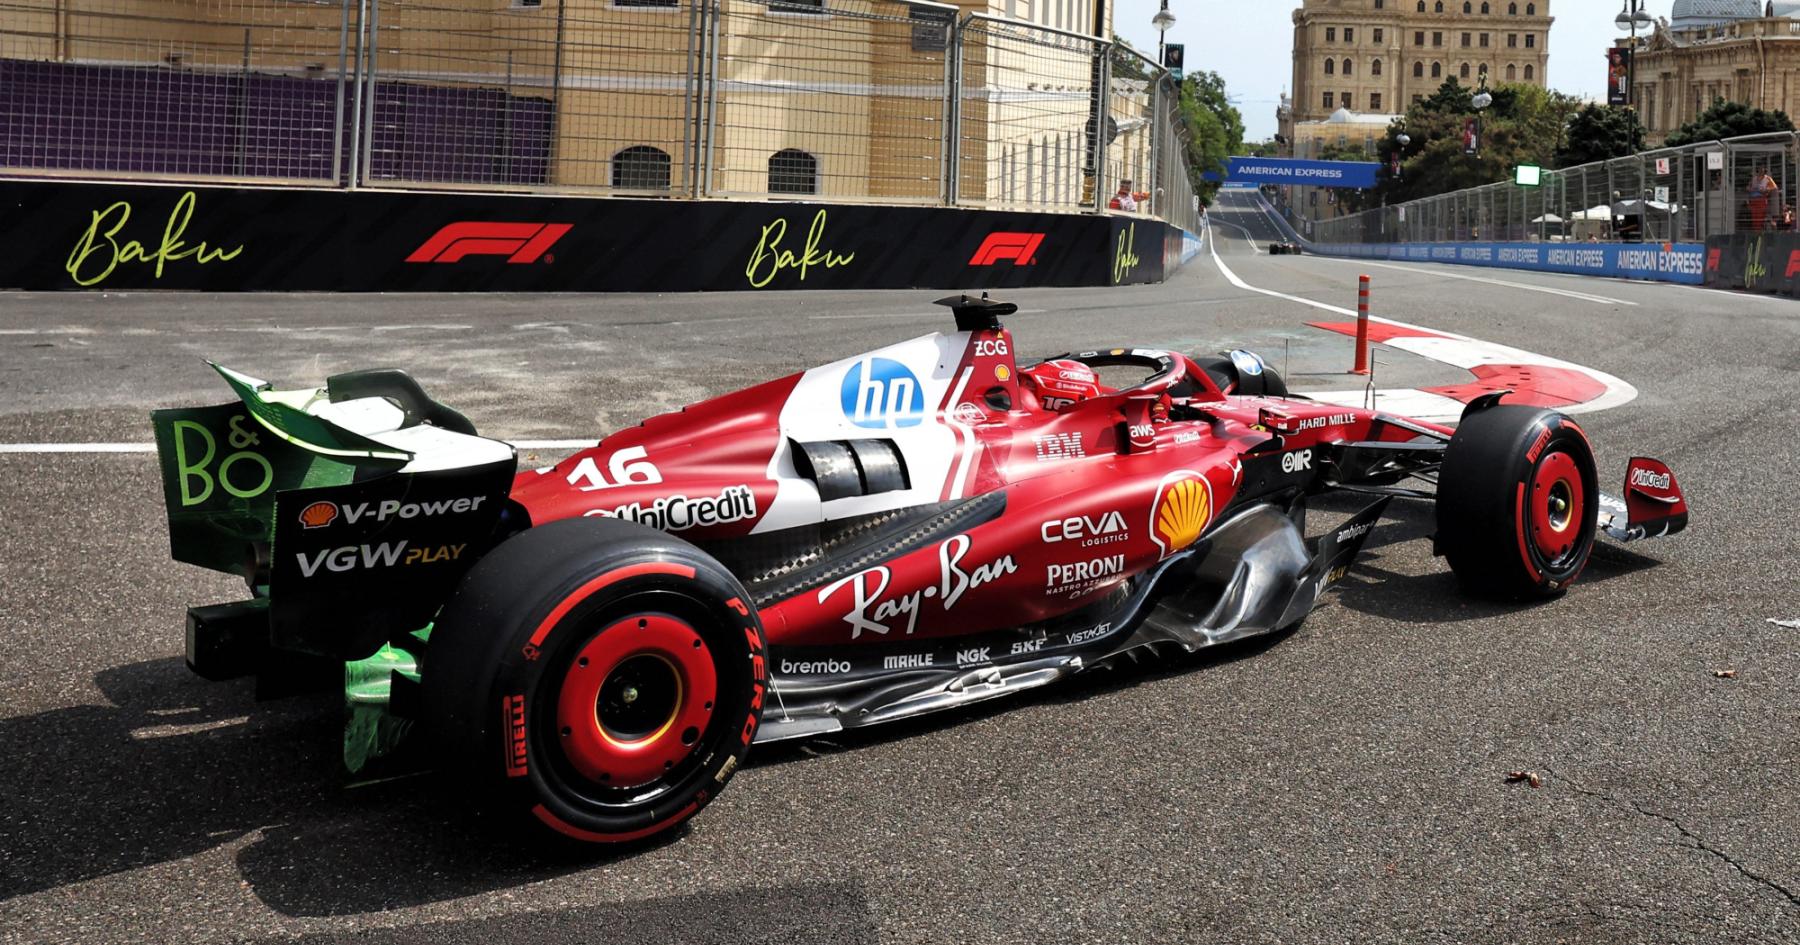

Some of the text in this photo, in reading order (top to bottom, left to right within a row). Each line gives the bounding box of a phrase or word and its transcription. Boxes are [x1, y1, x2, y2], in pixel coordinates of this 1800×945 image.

[1238, 165, 1342, 178] AMERICAN EXPRESS
[67, 191, 244, 286] Baku
[745, 209, 854, 288] Baku
[1114, 222, 1140, 283] Baku
[1547, 249, 1603, 268] AMERICAN EXPRESS
[1617, 250, 1703, 275] AMERICAN EXPRESS
[843, 357, 923, 428] hp
[1328, 413, 1356, 426] MILLE
[1129, 424, 1156, 438] aws
[1032, 432, 1085, 461] IBM
[566, 447, 663, 491] 16
[1638, 469, 1670, 488] UniCredit
[342, 495, 487, 525] V-Power
[1081, 532, 1129, 548] LOGISTICS
[296, 540, 467, 578] VGW PLAY
[1047, 554, 1125, 587] PERONI
[1046, 583, 1081, 595] NASTRO
[726, 597, 749, 616] P
[957, 647, 991, 664] NGK
[1011, 638, 1047, 655] SKF
[781, 658, 851, 674] brembo
[884, 653, 933, 669] MAHLE
[503, 695, 528, 777] PIRELLI
